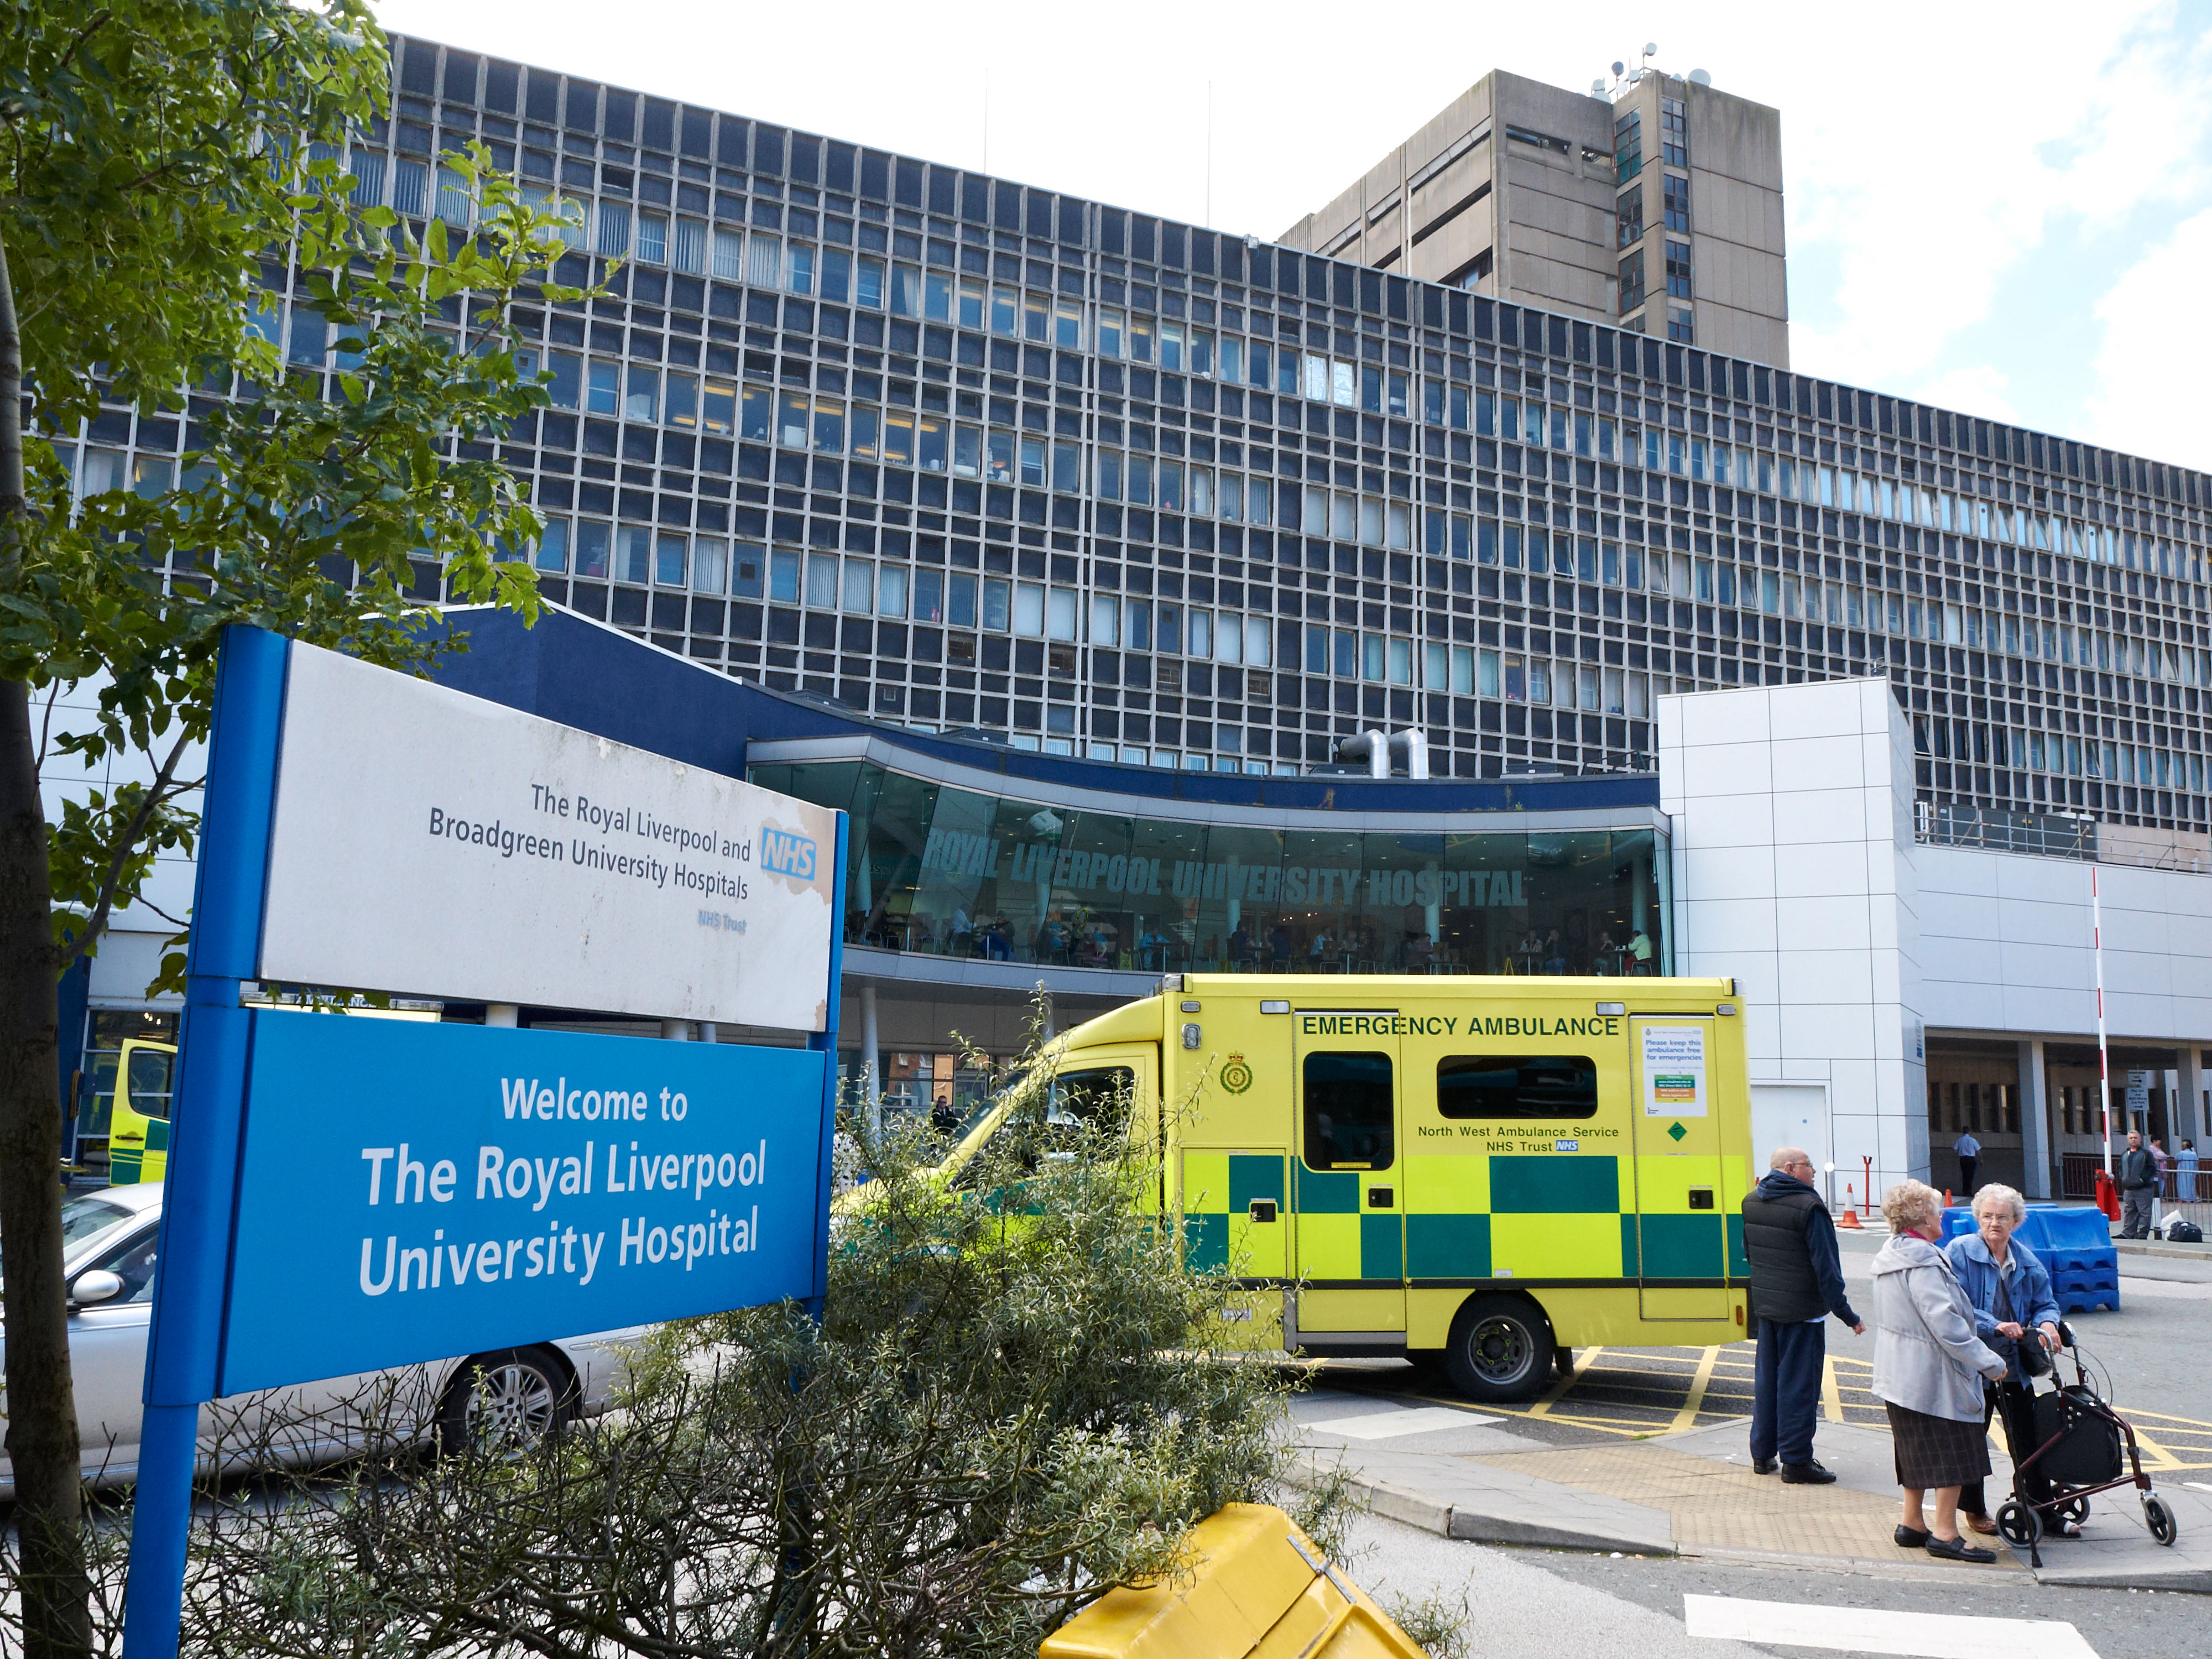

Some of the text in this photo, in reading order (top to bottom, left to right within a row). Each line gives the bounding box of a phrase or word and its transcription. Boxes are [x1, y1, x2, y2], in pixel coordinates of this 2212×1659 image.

[531, 784, 751, 862] The Royal Liverpool and
[429, 807, 748, 900] Broadgreen University Hospitals
[762, 832, 815, 876] NHS
[921, 827, 1527, 907] ROYAL LIVERPOOL UNIVERSITY HOSPITAL
[698, 910, 747, 933] NHS Trust
[1303, 1016, 1619, 1036] EMERGENCY AMBULANCE
[501, 1077, 687, 1121] Welcome to
[1418, 1126, 1619, 1138] North West Ambulance Service
[1486, 1141, 1578, 1152] NHS Trust NHS
[361, 1139, 766, 1212] The Royal Liverpool
[359, 1205, 758, 1296] University Hospital
